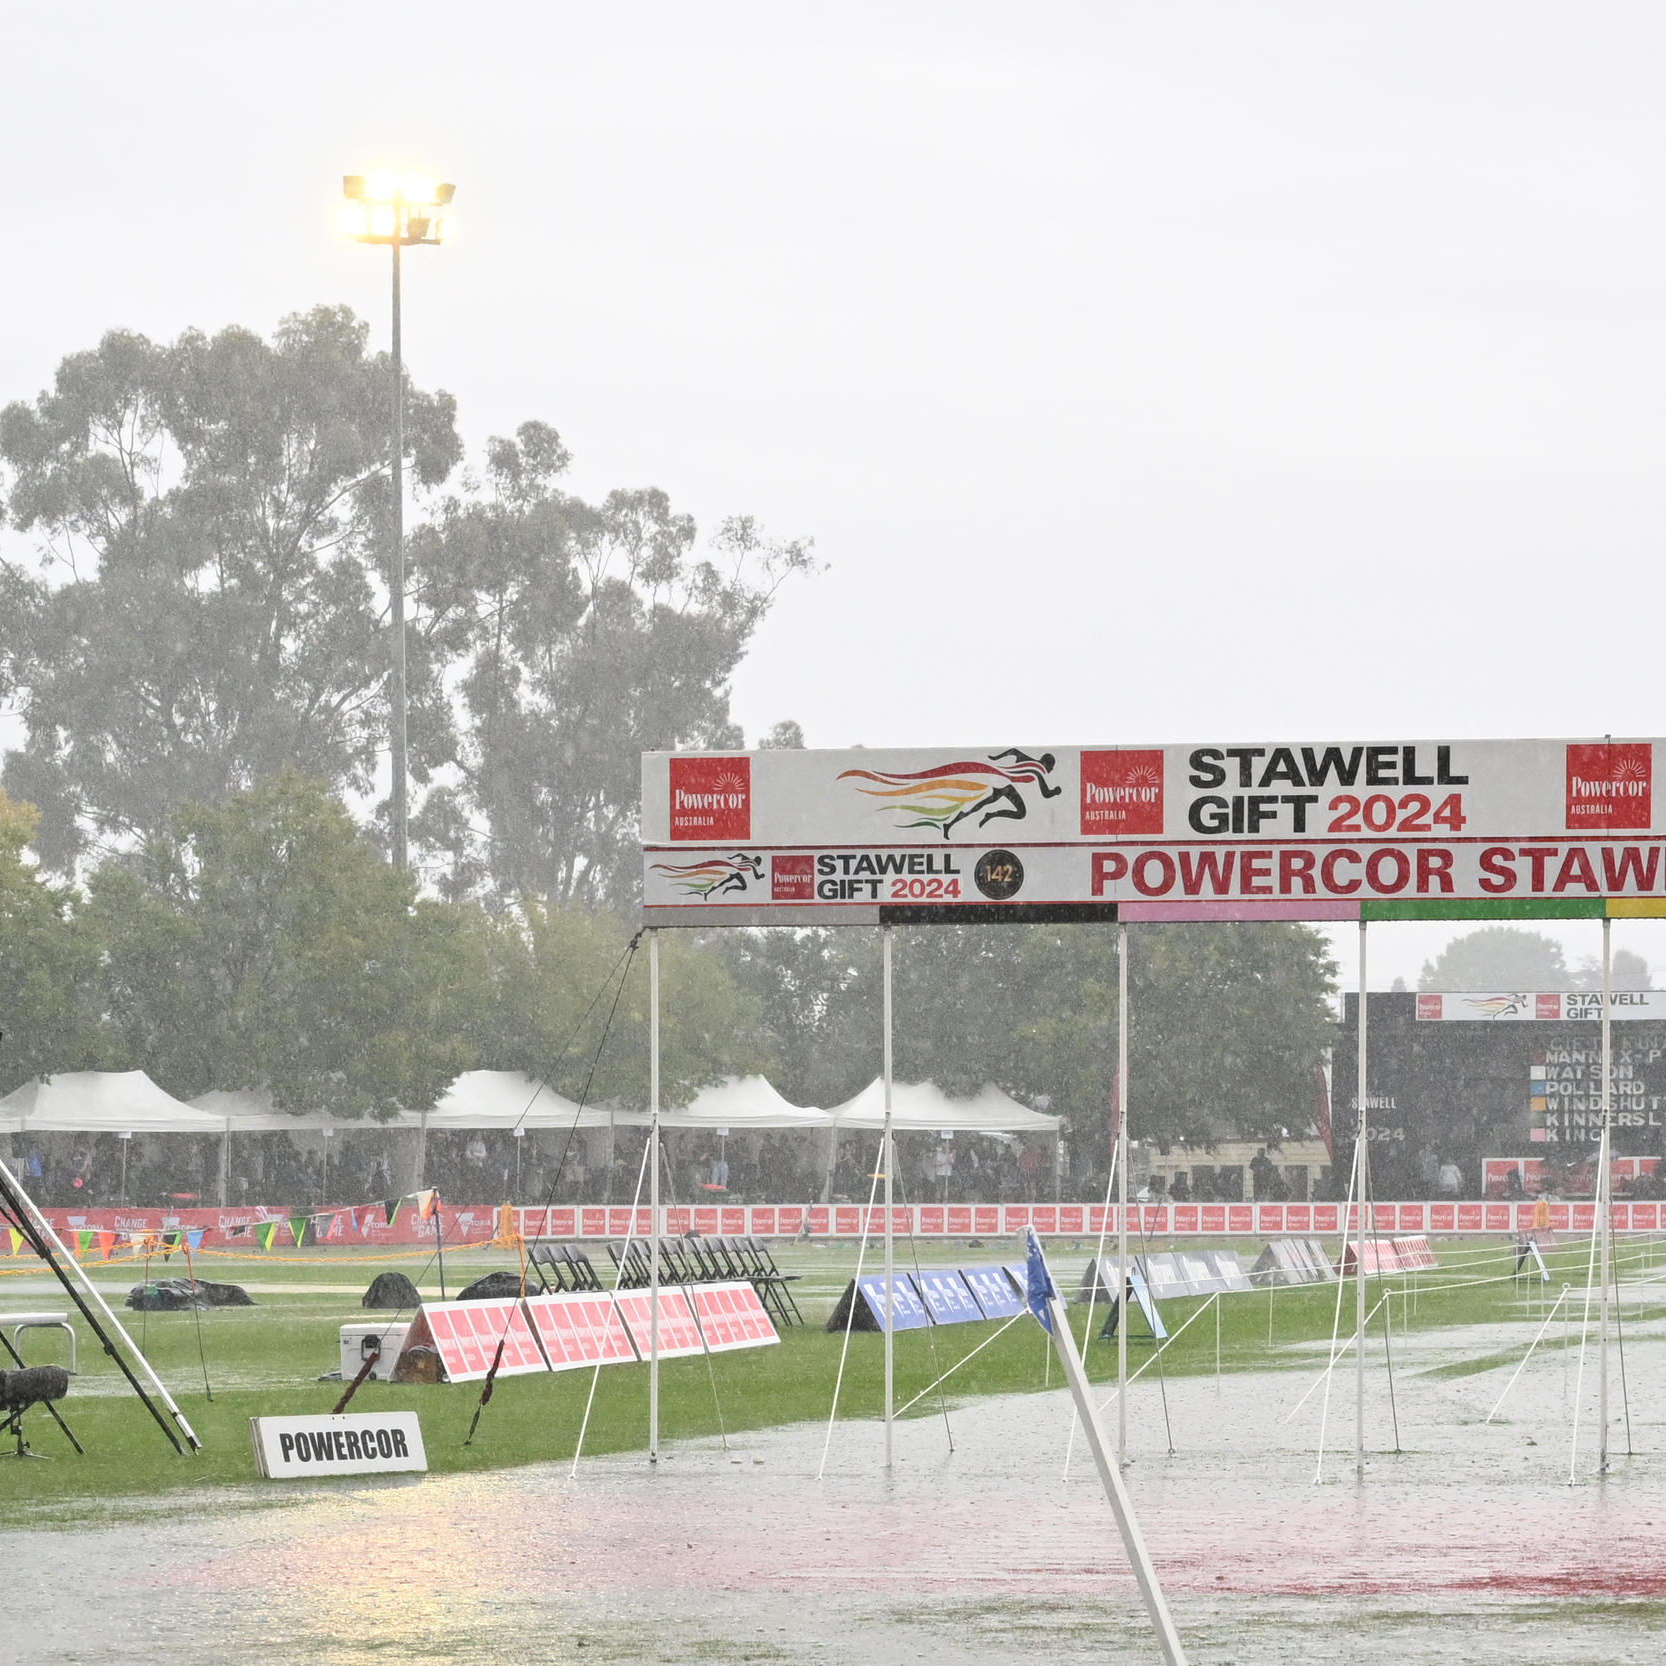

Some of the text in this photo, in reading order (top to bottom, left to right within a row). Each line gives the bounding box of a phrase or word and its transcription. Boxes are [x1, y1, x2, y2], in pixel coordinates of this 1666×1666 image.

[1188, 745, 1469, 789] STAWELL
[1085, 782, 1159, 805] Powercor
[1571, 776, 1647, 798] Powercor
[675, 788, 746, 810] Powercor
[1085, 810, 1127, 821] AUSTRALIA
[1188, 793, 1467, 835] GIFT 2024
[1570, 804, 1613, 815] AUSTRALIA
[674, 816, 714, 826] AUSTRALIA
[817, 853, 961, 876] STAWELL
[1090, 847, 1455, 897] POWERCOR
[774, 871, 812, 885] Powercor
[985, 864, 1014, 883] 142
[817, 878, 962, 900] GIFT 2024
[1566, 993, 1650, 1006] STAWELL
[1566, 1007, 1604, 1020] GIFT
[1546, 1065, 1634, 1080] WATSON
[1546, 1081, 1646, 1095] POLLARD
[1351, 1097, 1397, 1109] SAWELL
[114, 1215, 149, 1228] CHANGE
[279, 1428, 409, 1463] POWERCOR
